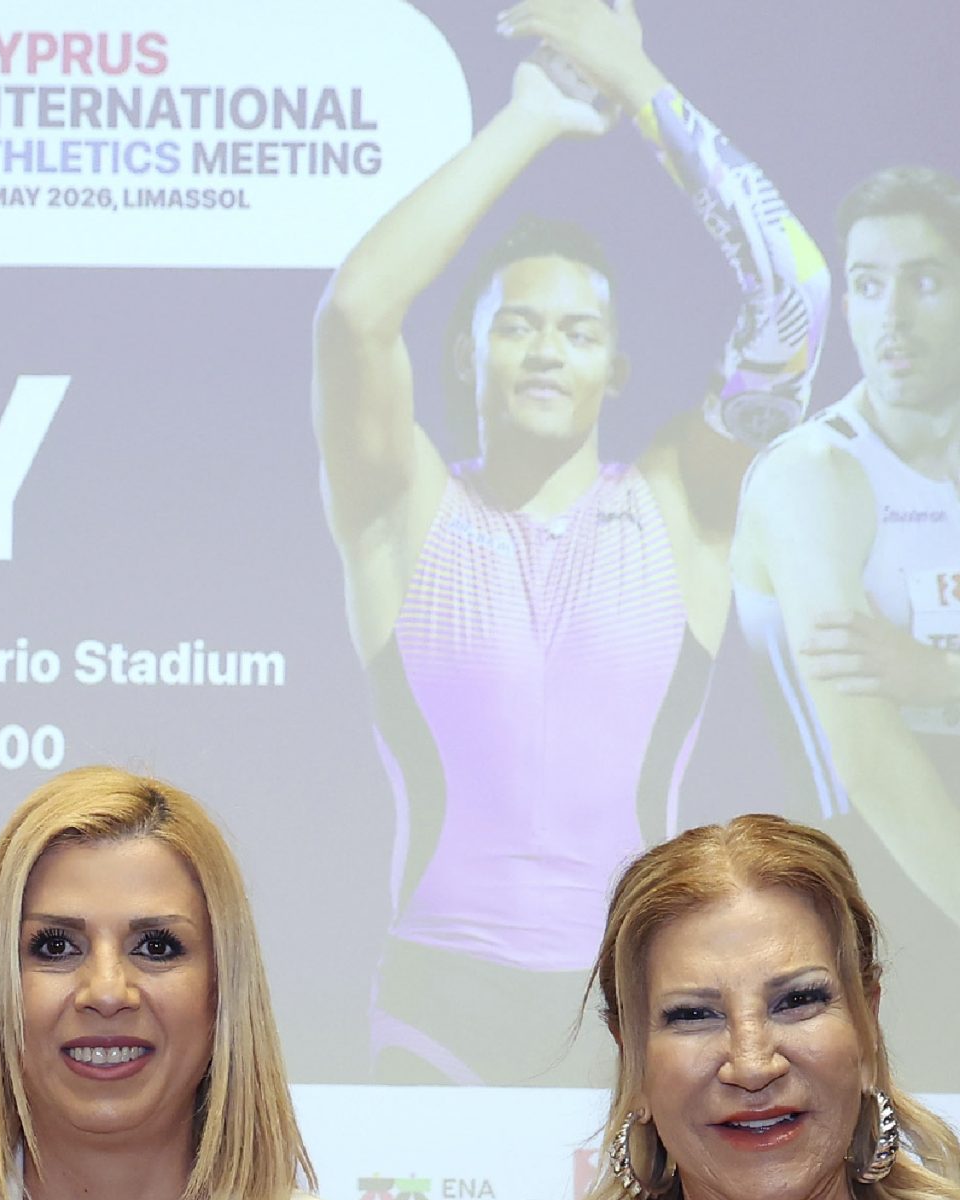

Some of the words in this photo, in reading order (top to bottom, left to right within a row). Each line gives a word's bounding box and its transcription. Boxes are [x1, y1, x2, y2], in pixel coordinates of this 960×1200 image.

[191, 141, 383, 177] MEETING
[47, 187, 119, 211] 2026,
[123, 188, 251, 209] LIMASSOL
[74, 639, 286, 687] Stadium
[443, 1178, 496, 1199] ENA
